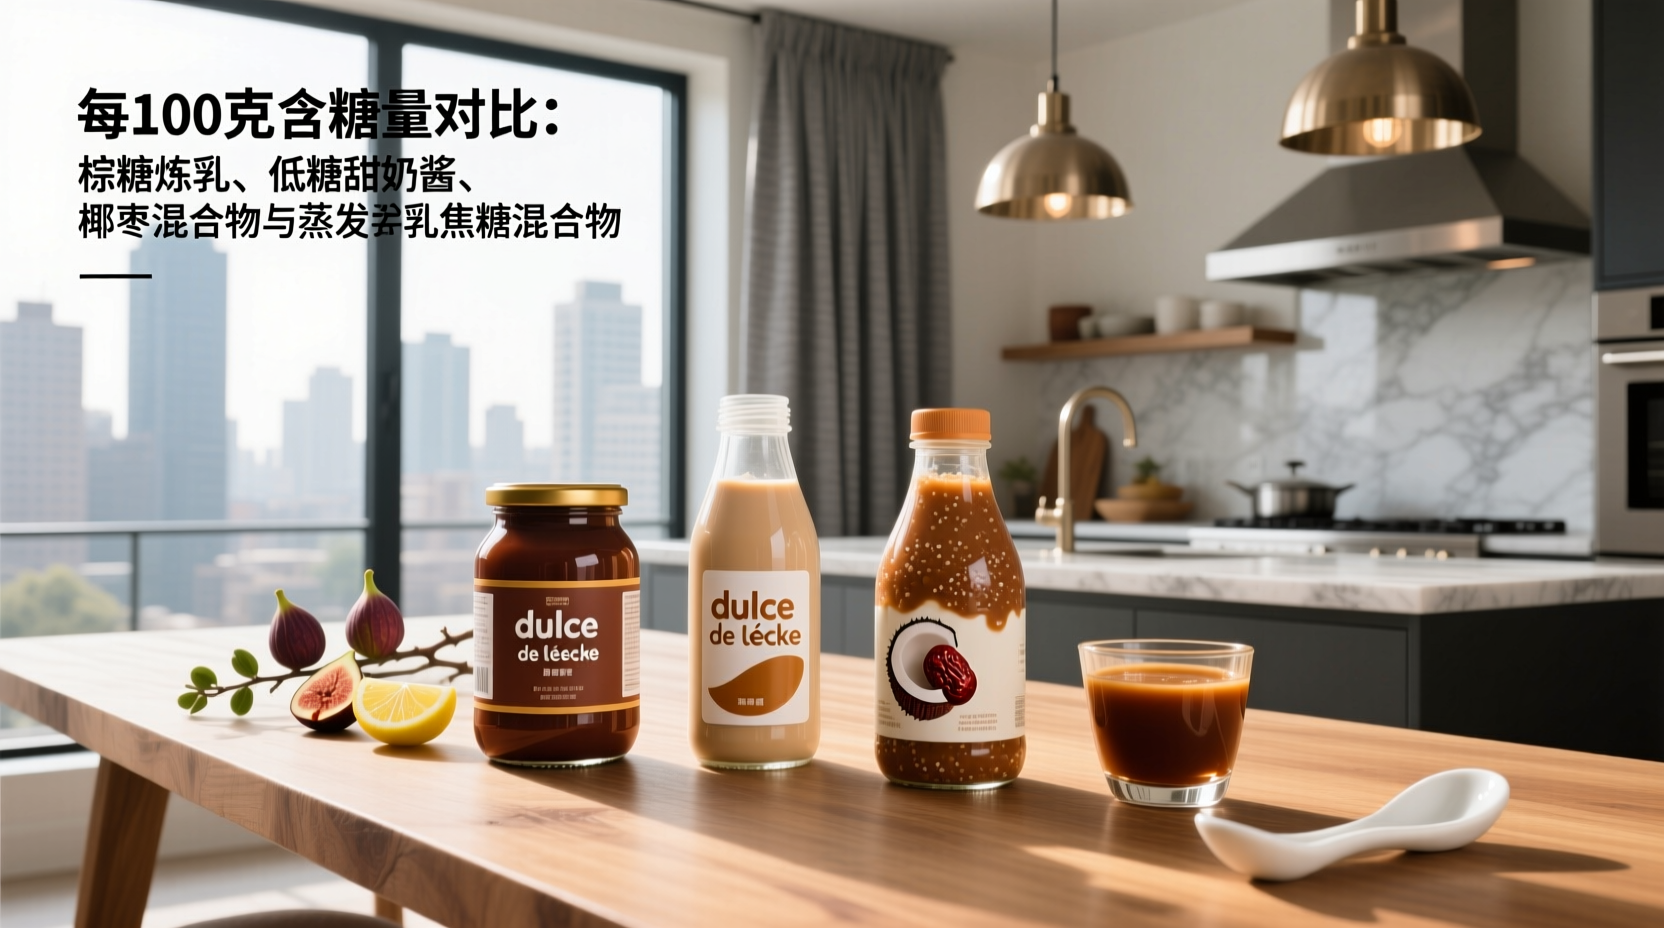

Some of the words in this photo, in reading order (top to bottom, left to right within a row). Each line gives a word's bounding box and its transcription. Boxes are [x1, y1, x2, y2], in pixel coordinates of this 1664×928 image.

[709, 589, 795, 621] dulce
[514, 609, 599, 640] dulce
[709, 622, 735, 646] de
[742, 622, 802, 646] lécke
[517, 644, 539, 662] de
